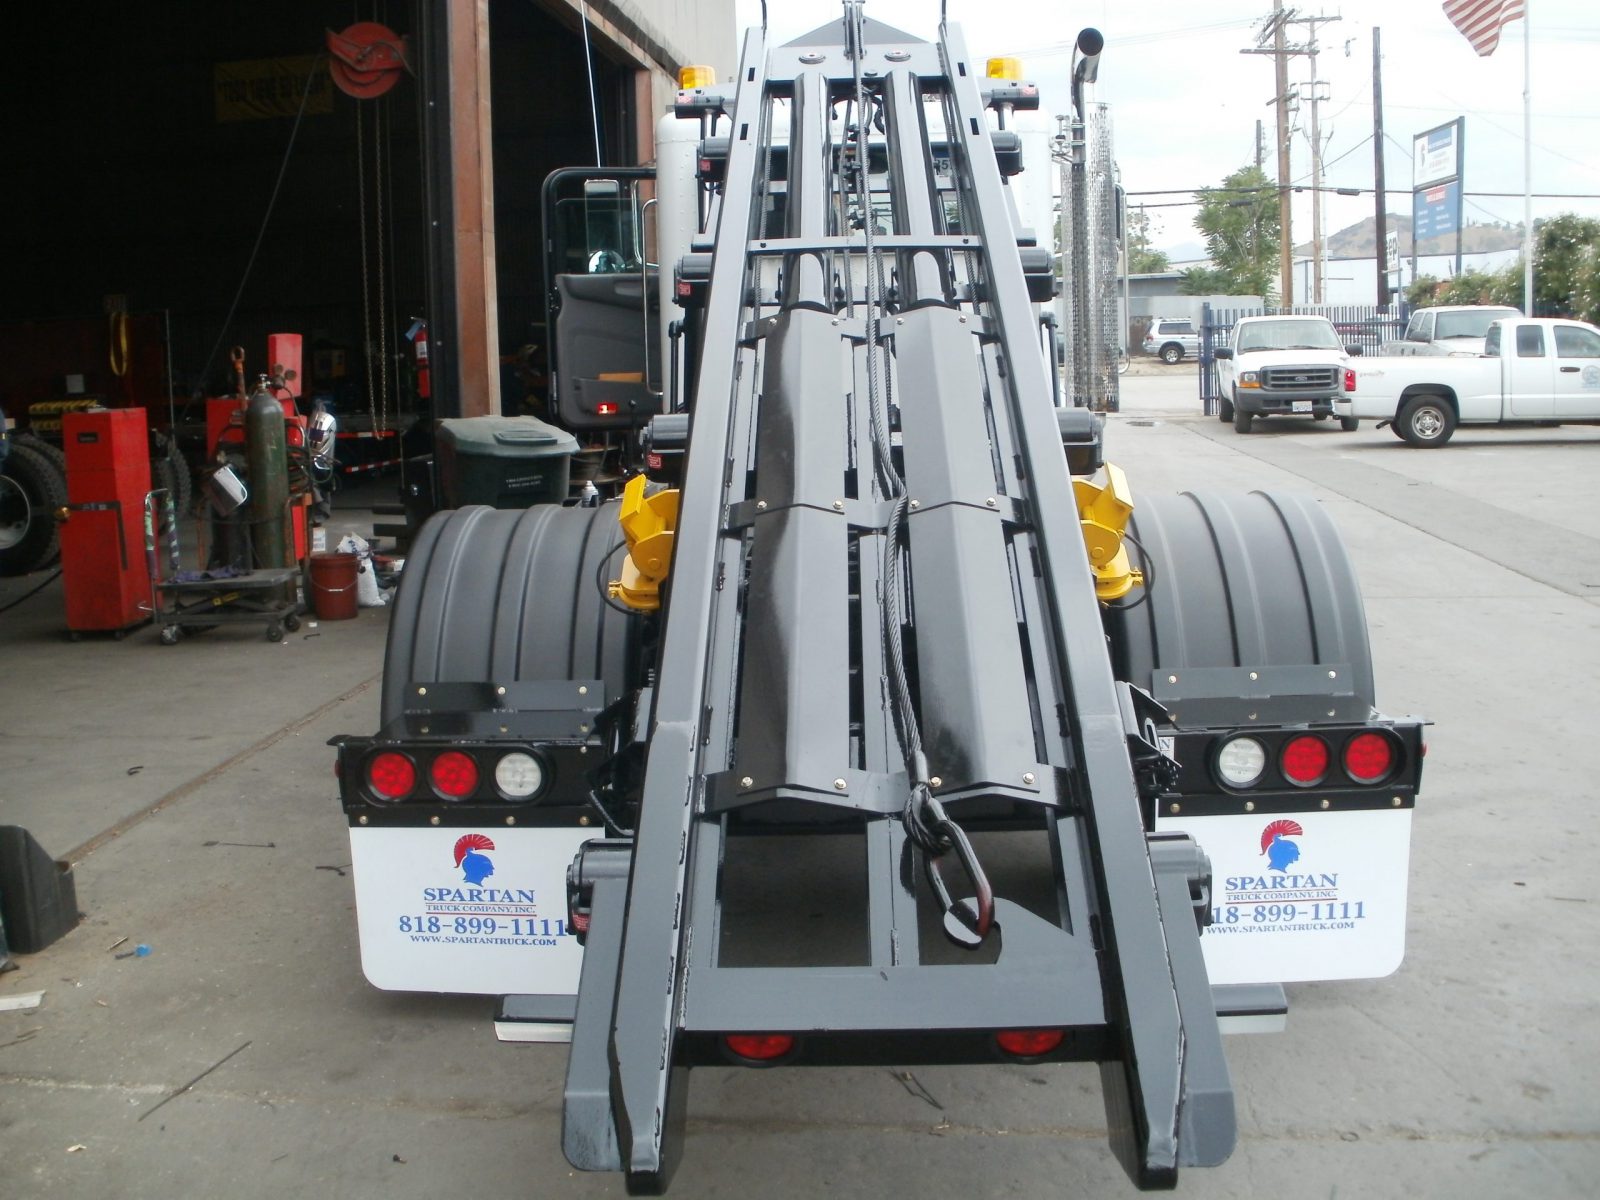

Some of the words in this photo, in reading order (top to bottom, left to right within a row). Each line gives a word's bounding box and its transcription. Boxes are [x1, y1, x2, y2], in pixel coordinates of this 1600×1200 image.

[1225, 873, 1338, 891] SPARTAN
[424, 887, 536, 903] SPARTAN
[1226, 893, 1262, 901] TRUCK
[1316, 890, 1337, 898] INC.
[426, 904, 461, 912] TRUCK
[514, 906, 536, 914] INC.
[1212, 901, 1366, 925] 18-899-1111
[399, 915, 567, 937] 818-899-1111
[1207, 921, 1355, 934] WWW.SPARTANTRUCK.COM
[410, 935, 557, 946] WWW.SPARTANTRUCK.COM
